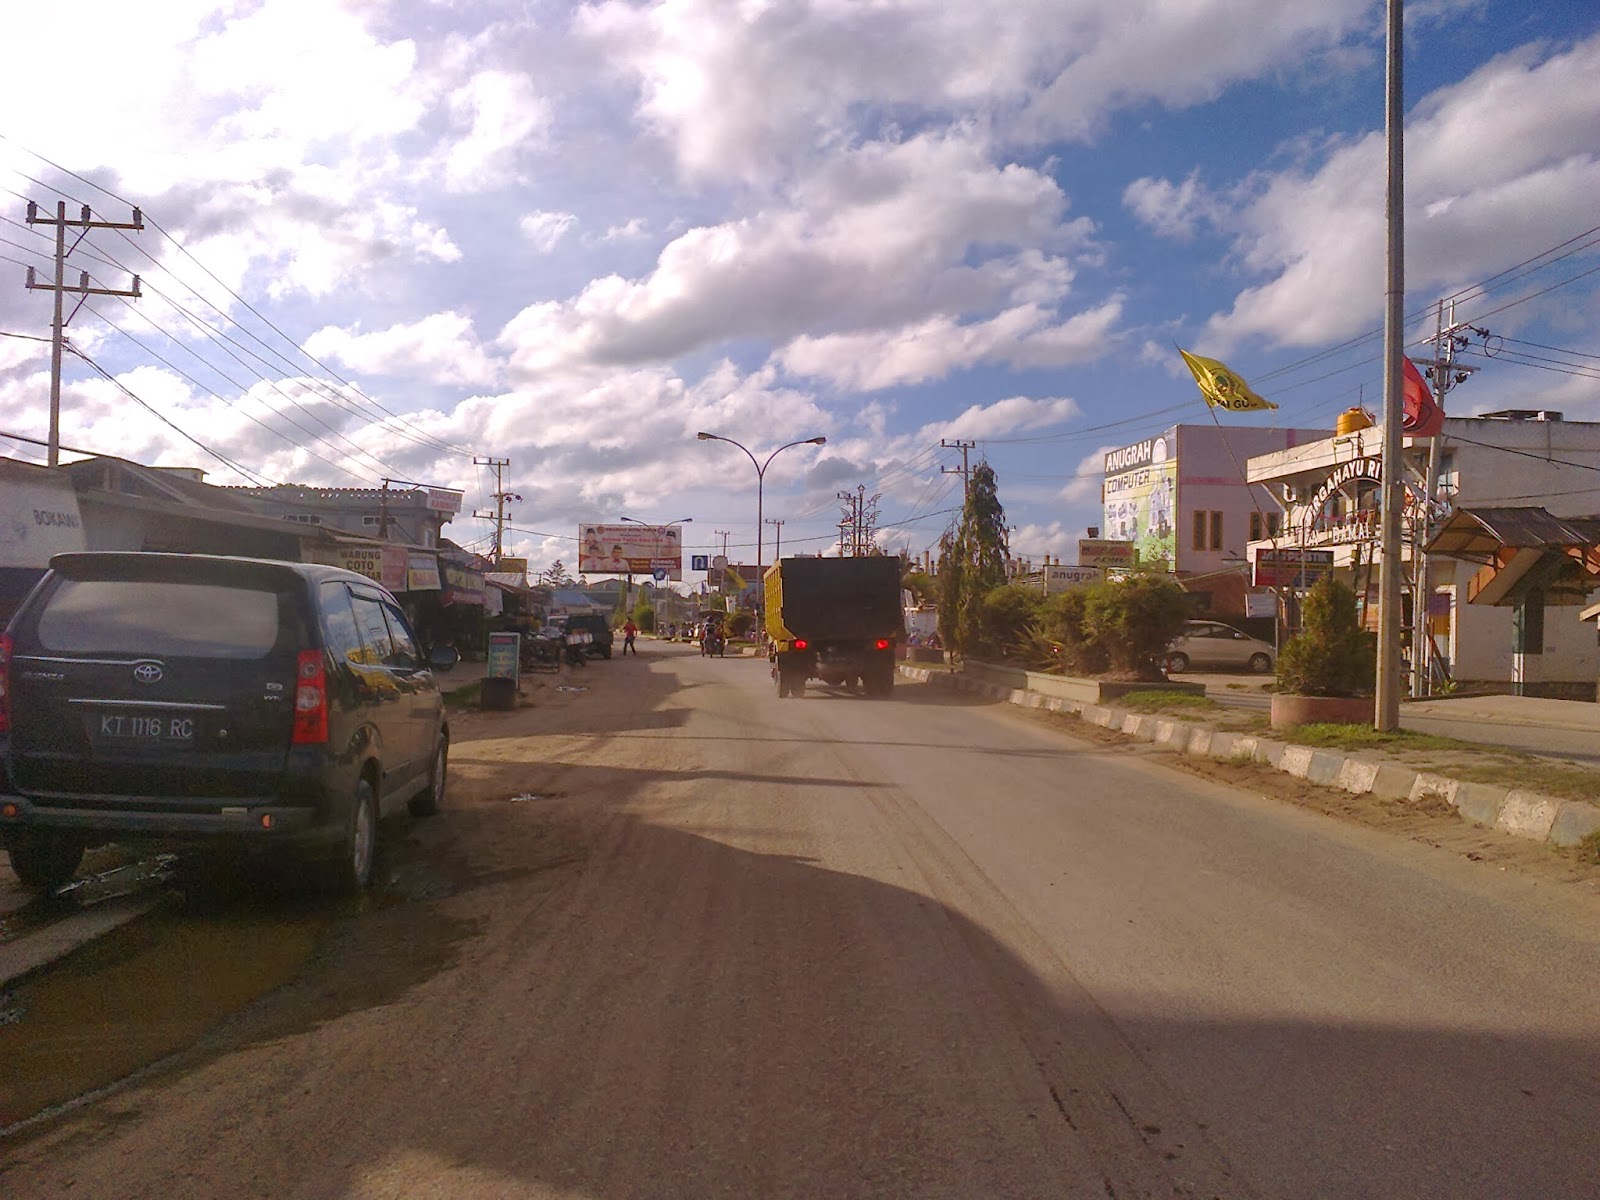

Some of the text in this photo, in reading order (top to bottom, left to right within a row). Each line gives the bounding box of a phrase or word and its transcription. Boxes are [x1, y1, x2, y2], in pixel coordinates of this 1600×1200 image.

[1106, 439, 1152, 472] ANUGRAH
[1367, 459, 1381, 479] RI
[1107, 469, 1150, 494] COMPUTER
[340, 551, 381, 560] WARUNG
[346, 560, 374, 571] COTO
[101, 715, 125, 735] KT
[170, 719, 193, 737] RC
